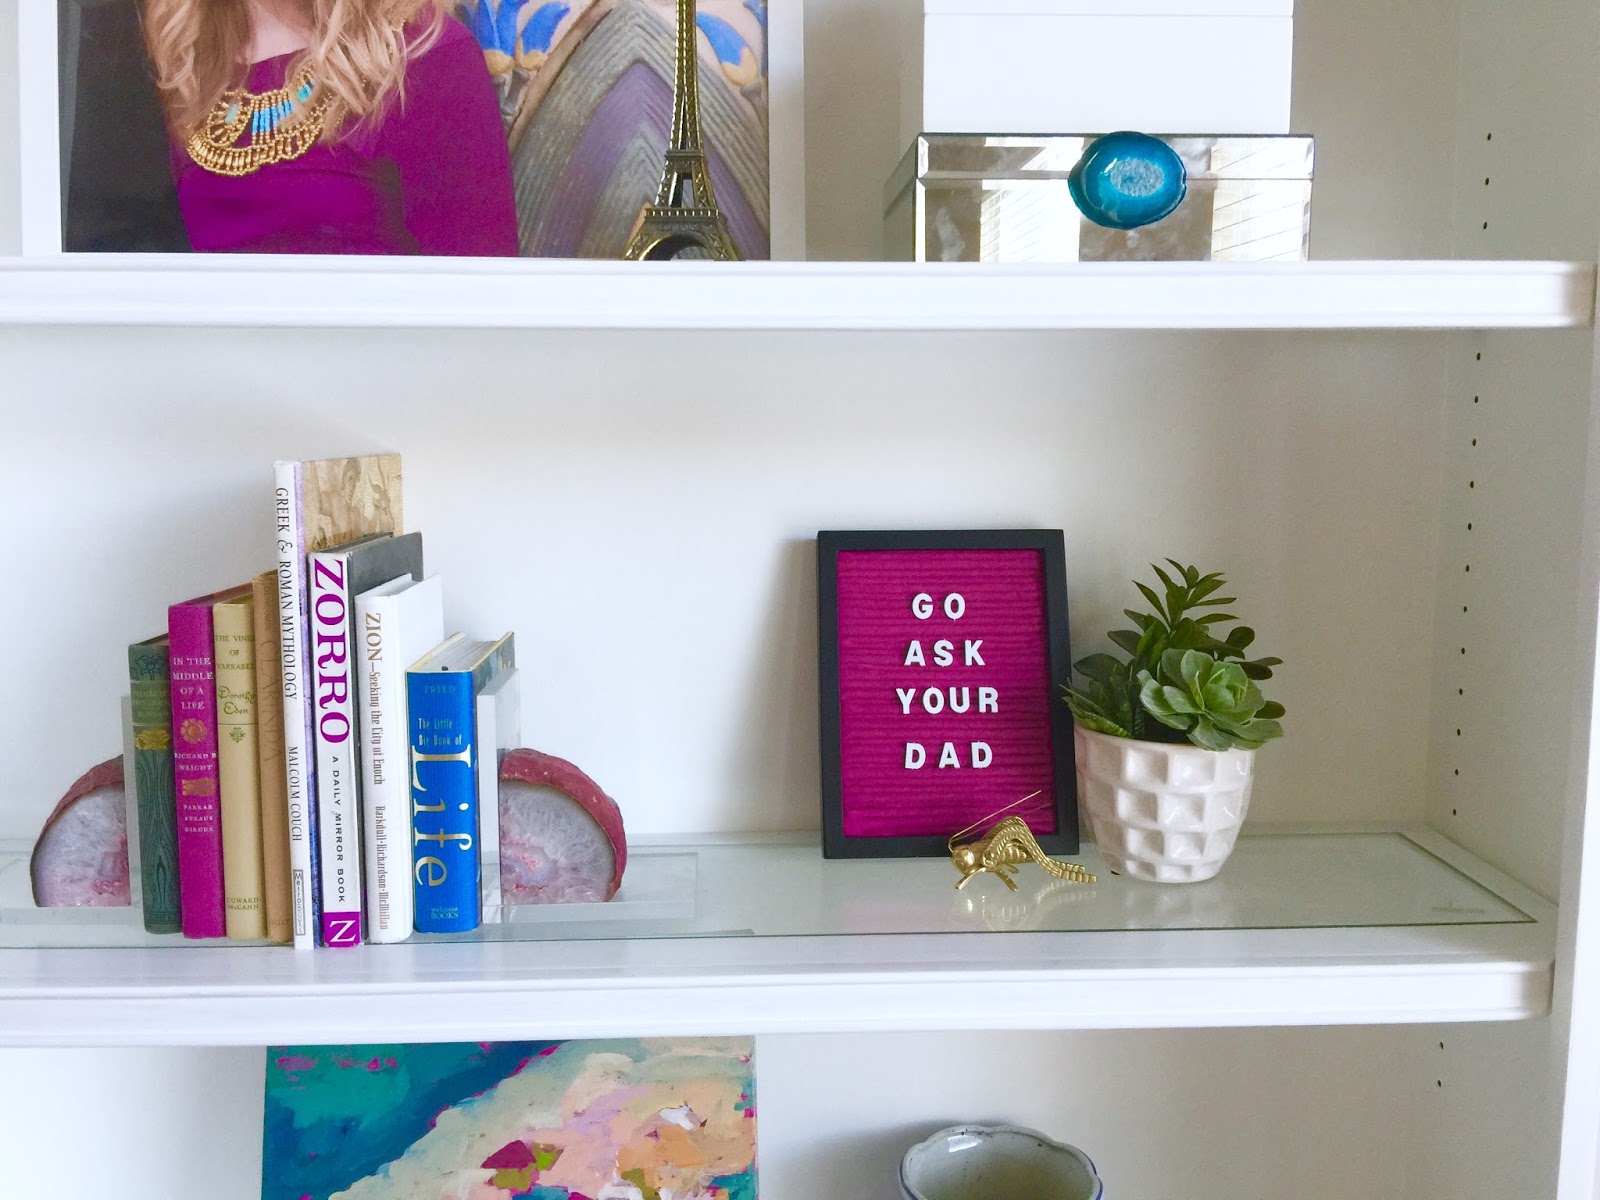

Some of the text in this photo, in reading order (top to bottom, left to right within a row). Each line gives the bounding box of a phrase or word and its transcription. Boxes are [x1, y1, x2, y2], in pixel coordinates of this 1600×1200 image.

[276, 487, 297, 700] GREEK & ROMAN MYTHOLOGY
[912, 592, 966, 621] GO
[173, 657, 211, 666] IN THE
[314, 558, 350, 743] ZORRO
[904, 639, 985, 668] ASK
[173, 672, 214, 680] MIDDLE
[180, 687, 194, 695] OF
[197, 687, 204, 695] A
[424, 685, 456, 694] FRIED
[896, 686, 999, 714] YOUR
[181, 701, 205, 710] LIFE
[223, 701, 249, 715] Eden
[371, 711, 383, 725] the
[371, 727, 384, 746] City
[418, 717, 430, 730] The
[174, 752, 209, 760] RICHARD
[179, 764, 213, 772] WRIGHT
[904, 741, 993, 770] DAD
[373, 758, 386, 786] Enoch
[288, 746, 302, 841] MALCOLM COUCH
[332, 770, 341, 806] DAILY
[412, 744, 473, 888] Life
[334, 812, 344, 862] MIRROR
[337, 868, 346, 903] BOOK
[329, 919, 356, 943] Z
